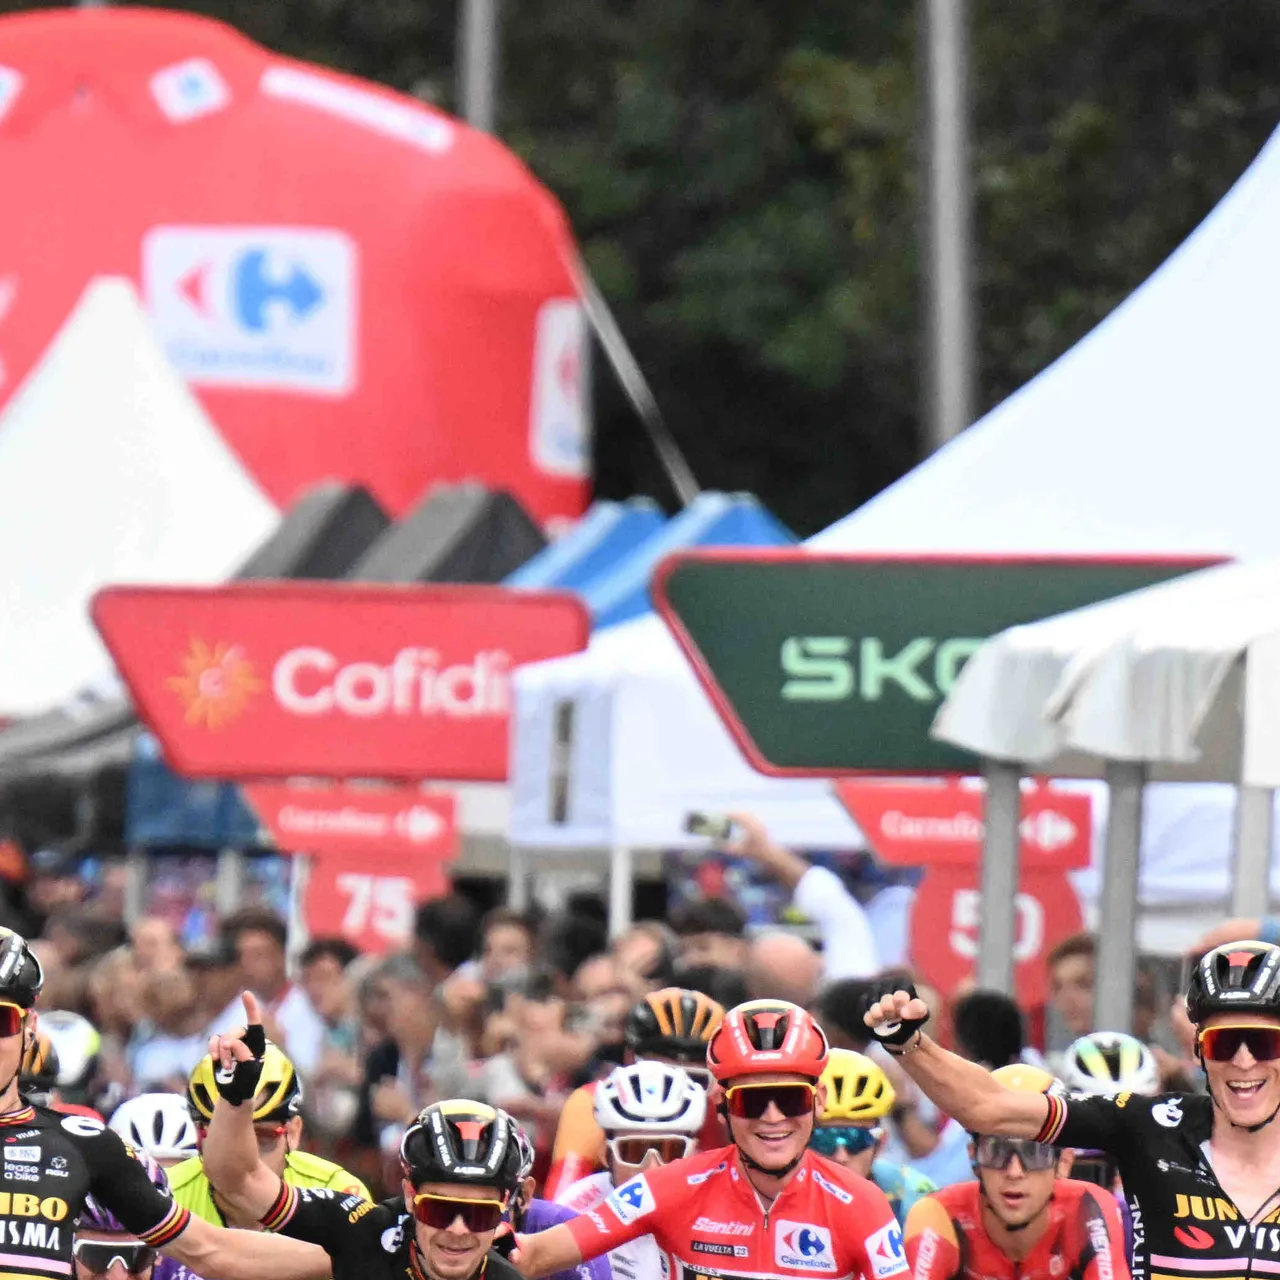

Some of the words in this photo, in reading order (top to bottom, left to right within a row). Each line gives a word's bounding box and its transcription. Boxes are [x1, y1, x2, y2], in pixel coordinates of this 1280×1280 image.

[272, 646, 513, 716] Cofidi
[780, 635, 980, 702] SKO
[335, 875, 416, 936] 75
[4, 1162, 39, 1173] lease
[692, 1217, 756, 1237] Santini
[781, 1255, 832, 1269] Carrefour
